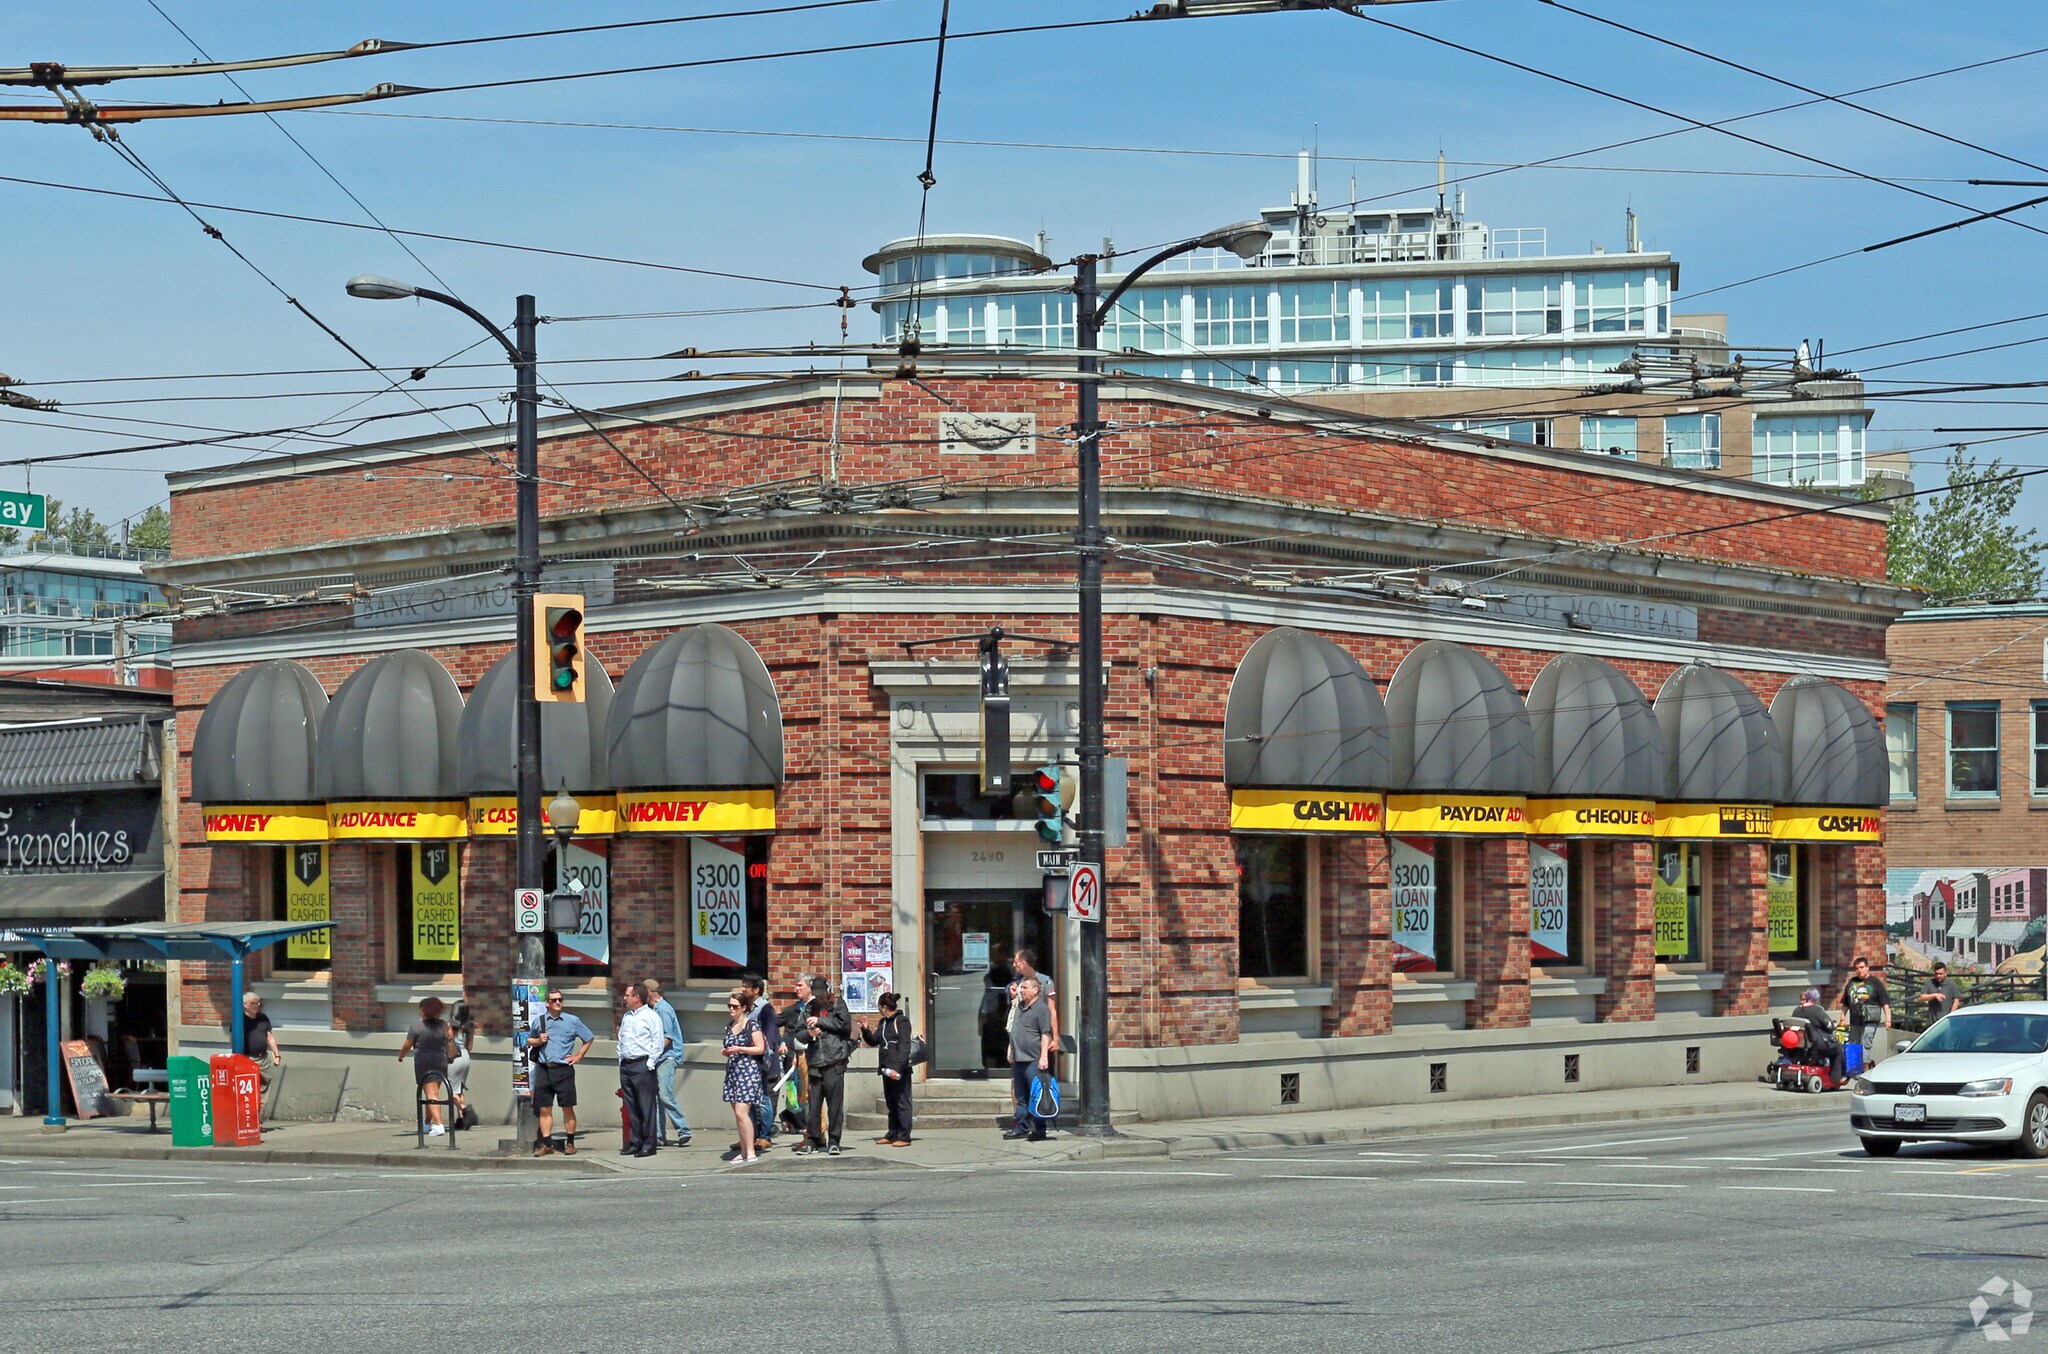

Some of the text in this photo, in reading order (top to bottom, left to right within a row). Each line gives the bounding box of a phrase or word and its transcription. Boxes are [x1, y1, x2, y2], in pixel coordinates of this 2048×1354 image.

[0, 501, 33, 525] ay
[431, 588, 457, 613] OF
[1524, 593, 1550, 619] OF
[340, 812, 417, 827] ADVANCE
[1440, 806, 1504, 821] PAYDAY
[1576, 809, 1638, 825] CHEQUE
[300, 852, 317, 879] 1ST
[427, 850, 446, 877] 1ST
[971, 851, 1004, 863] 2490
[1043, 854, 1061, 866] MAIN
[1663, 852, 1678, 879] 1ST
[1774, 853, 1788, 878] 1ST
[696, 864, 740, 888] $300
[1395, 864, 1430, 887] $300
[1532, 866, 1563, 888] $300
[291, 892, 325, 906] CHEQUE
[417, 892, 454, 906] CHEQUE
[580, 891, 602, 909] AN
[698, 890, 740, 910] LOAN
[1395, 888, 1429, 907] LOAN
[1533, 889, 1563, 907] LOAN
[1655, 892, 1684, 904] CHEQUE
[291, 908, 326, 922] CASHED
[417, 908, 455, 922] CASHED
[1404, 909, 1429, 931] $20
[1540, 909, 1563, 930] $20
[1655, 906, 1684, 919] CASHED
[709, 912, 740, 936] $20
[1655, 922, 1684, 941] FREE
[418, 924, 454, 945] FREE
[239, 1079, 253, 1095] 24
